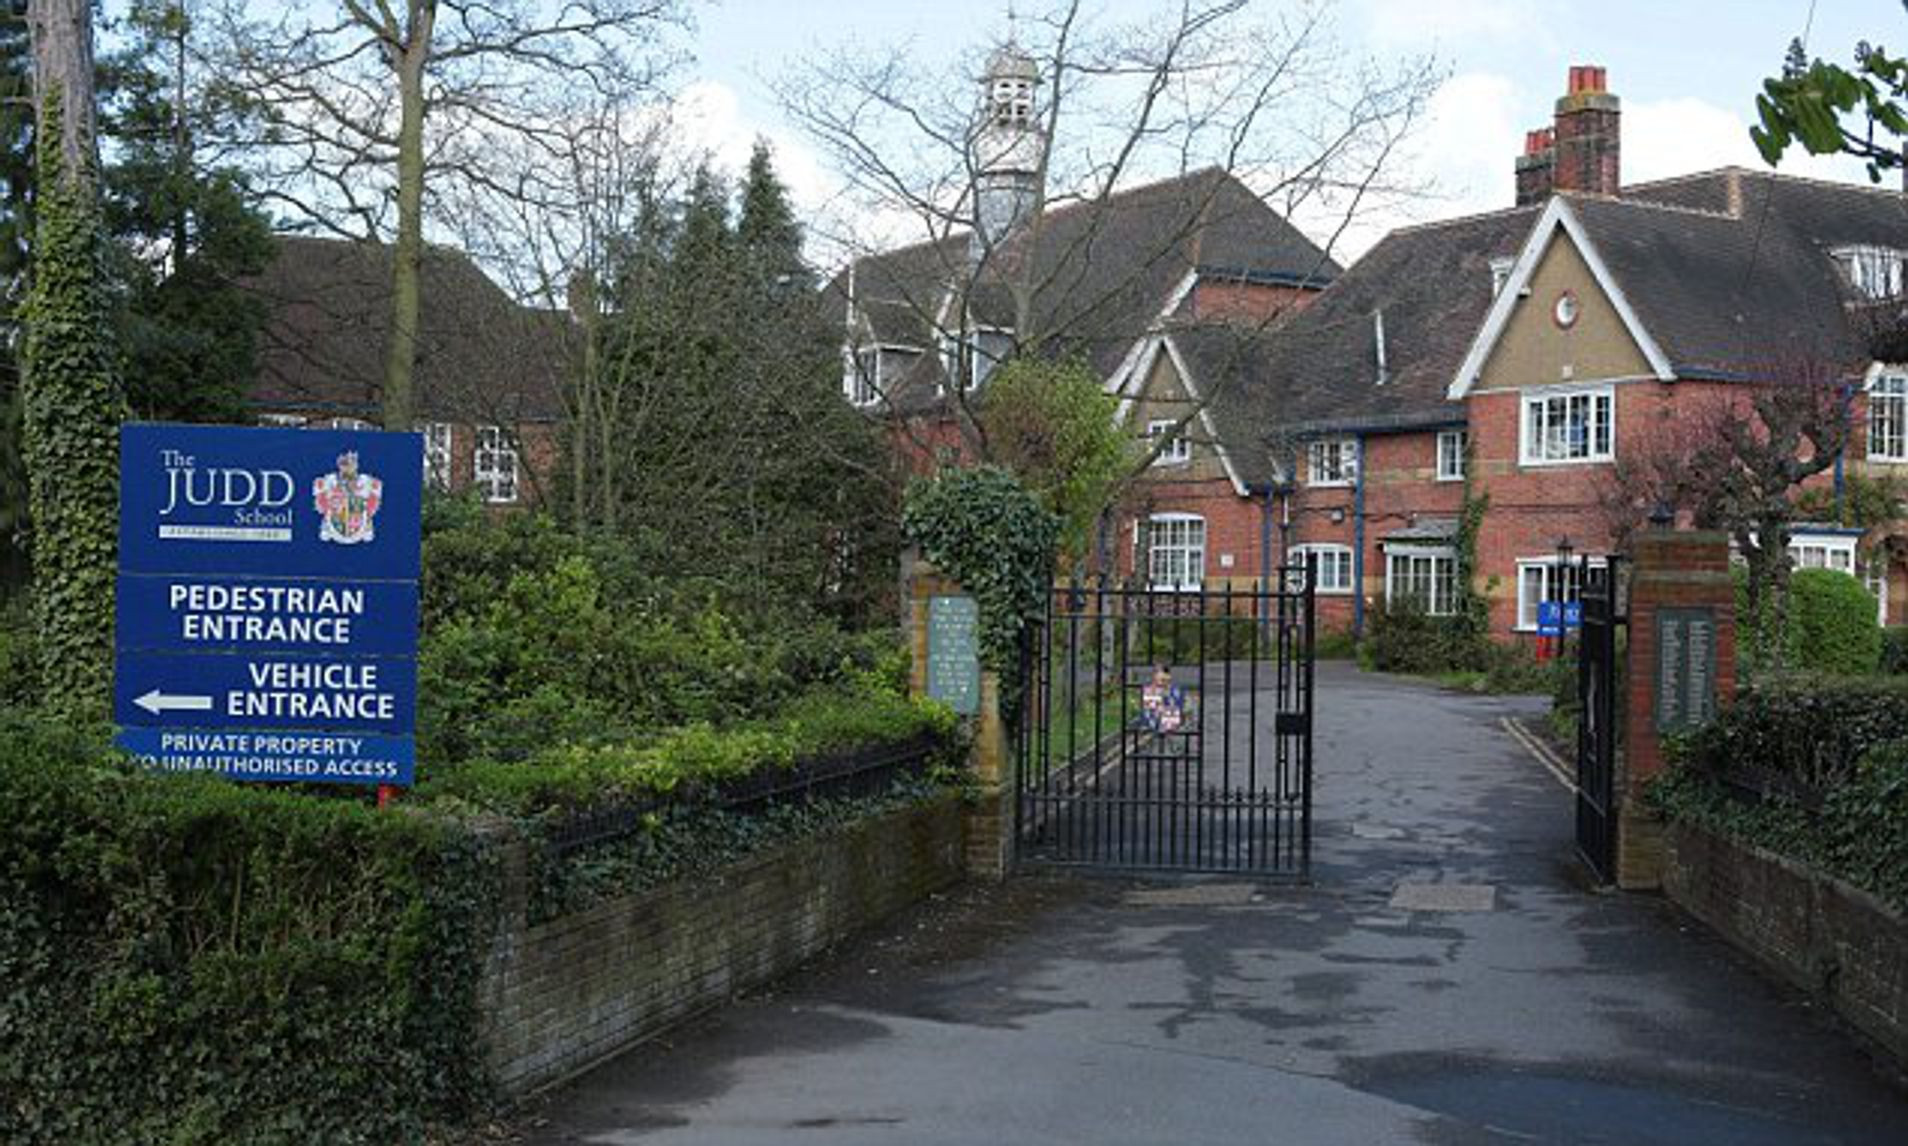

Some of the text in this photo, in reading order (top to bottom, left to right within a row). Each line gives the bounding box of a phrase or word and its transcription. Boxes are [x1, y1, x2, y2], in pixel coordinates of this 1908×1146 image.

[160, 450, 195, 467] The
[159, 468, 295, 515] JUDD
[234, 508, 293, 526] School
[170, 584, 364, 615] PEDESTRIAN
[183, 614, 350, 643] ENTRANCE
[249, 662, 377, 690] VEHICLE
[227, 691, 394, 719] ENTRANCE
[161, 733, 363, 756] PRIVATE PROPERTY
[161, 755, 319, 775] UNAUTHORISED
[324, 759, 398, 778] ACCESS
